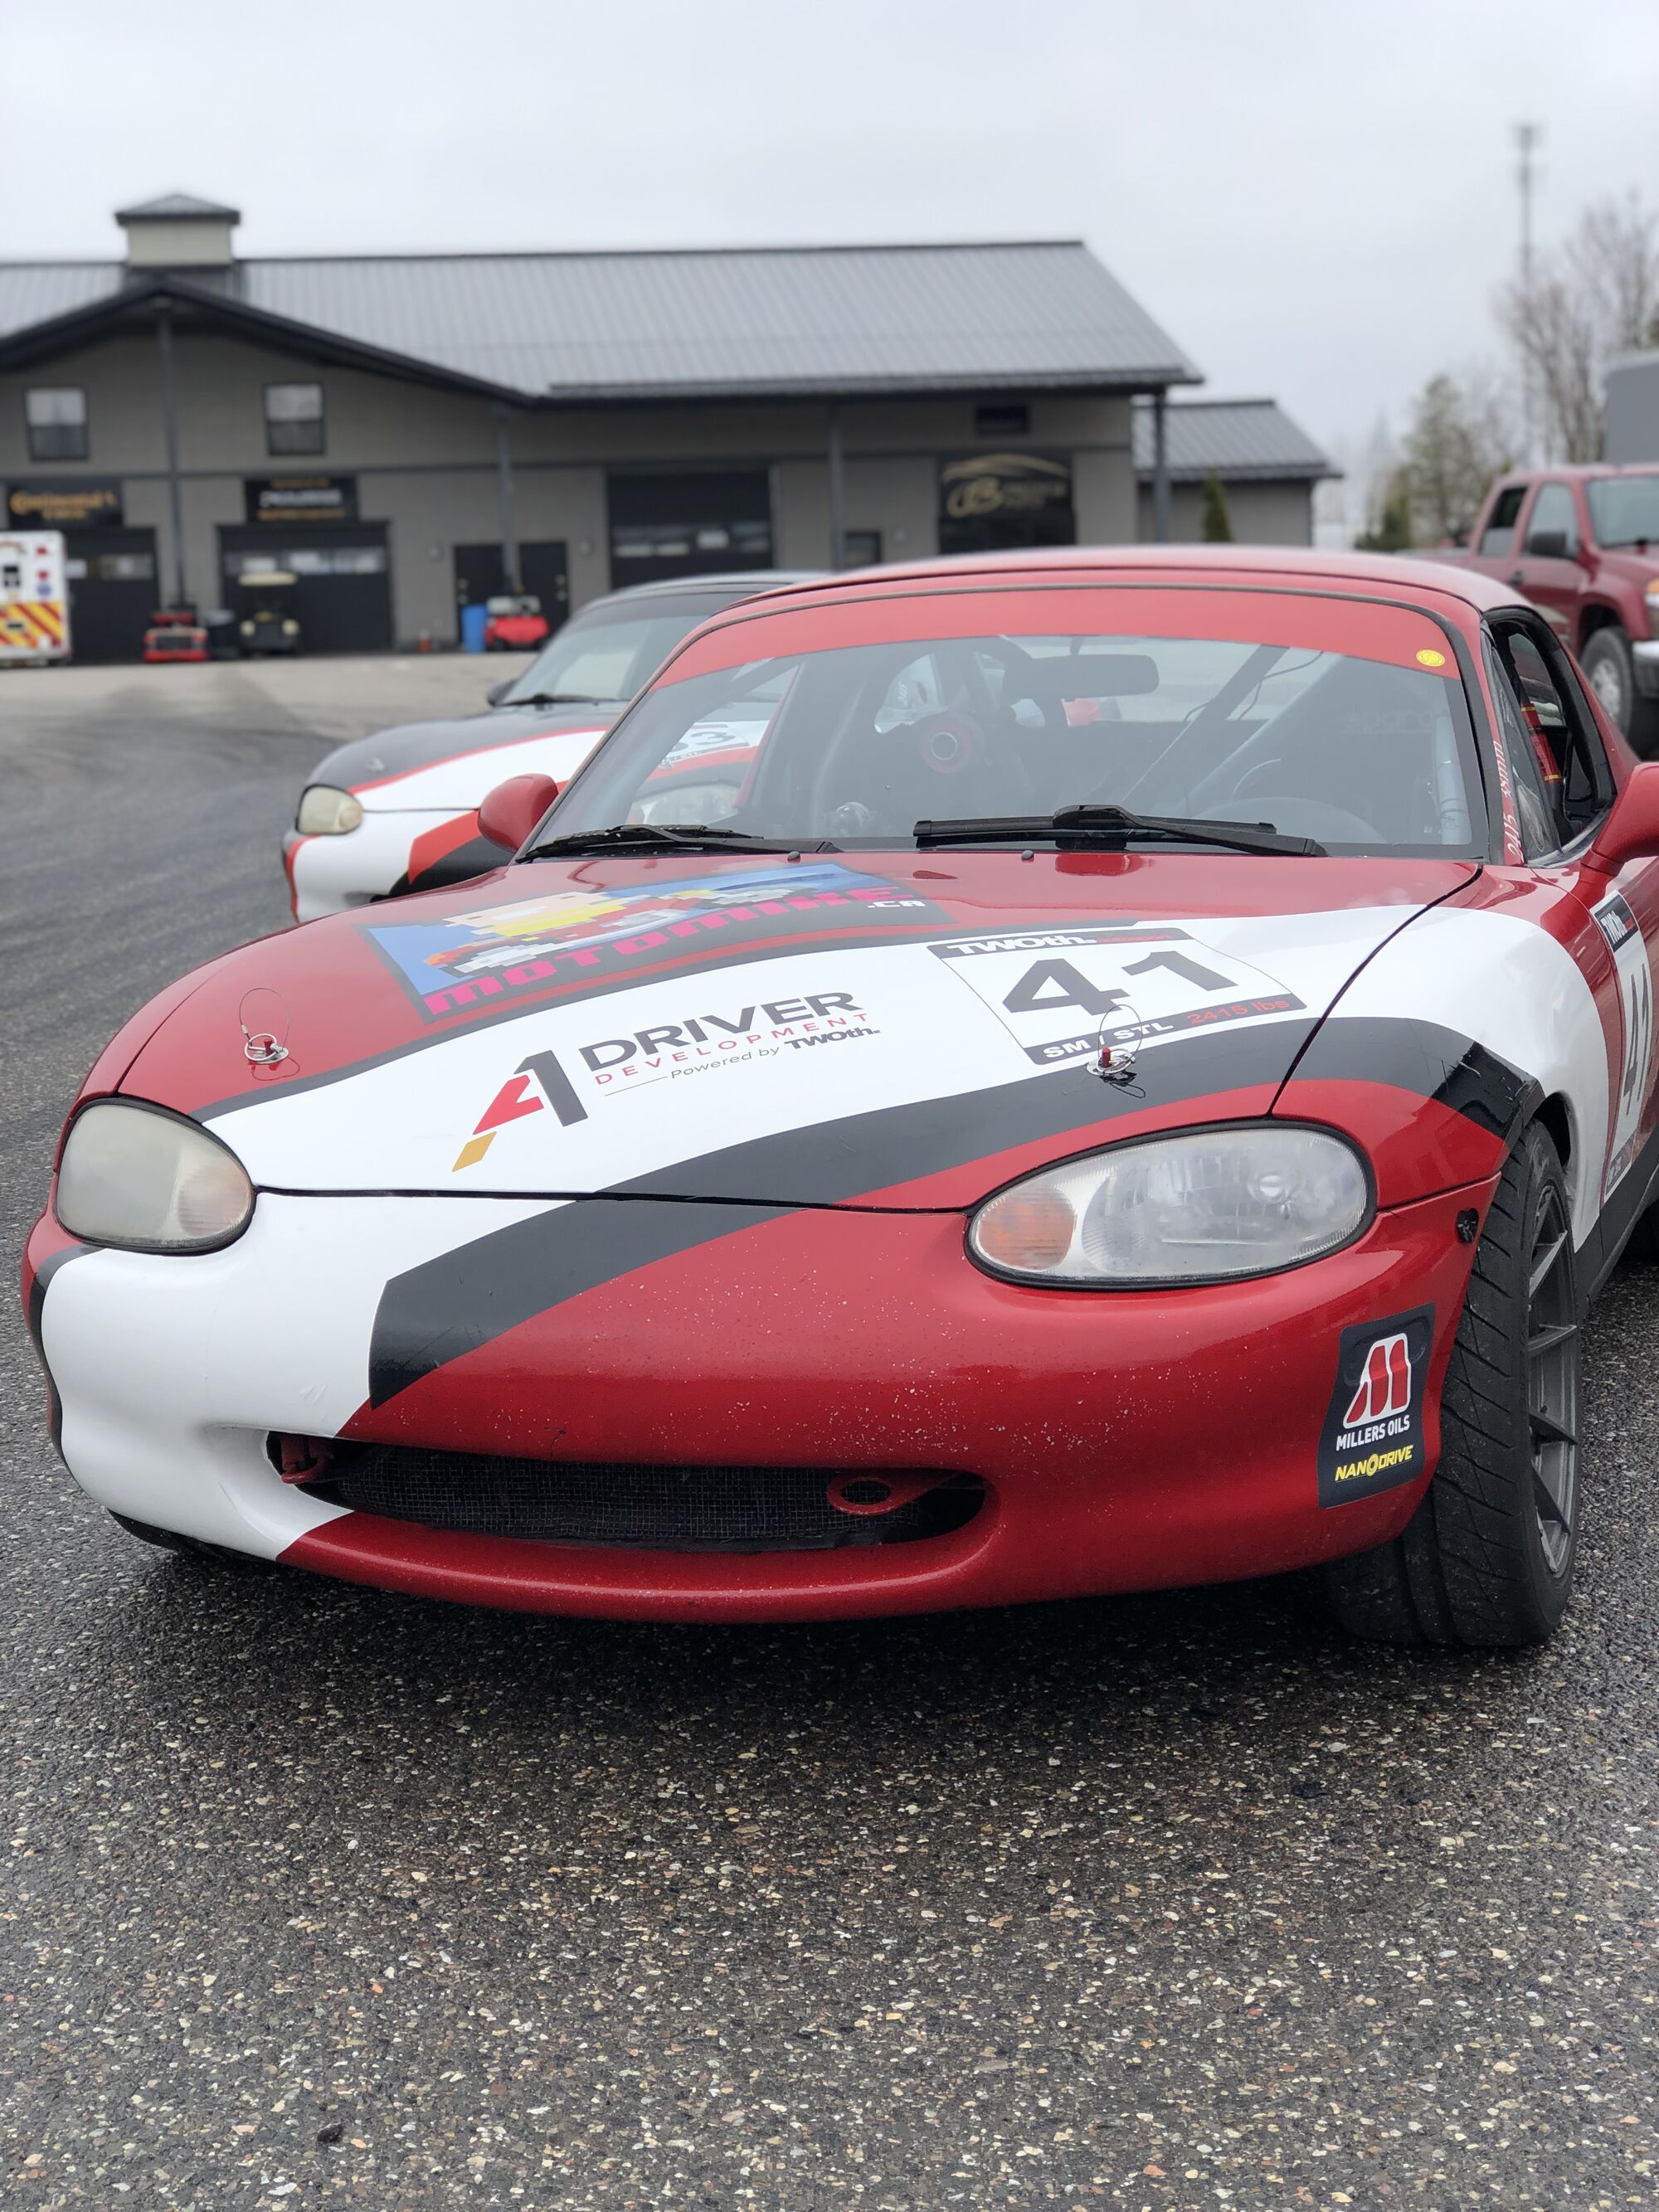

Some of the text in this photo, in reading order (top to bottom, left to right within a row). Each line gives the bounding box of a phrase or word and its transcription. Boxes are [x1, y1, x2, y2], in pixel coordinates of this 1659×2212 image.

[1503, 812, 1525, 864] 2415
[1002, 950, 1239, 1017] 41
[578, 992, 864, 1072] DRIVER
[595, 1013, 868, 1085] DEVELOPMENT
[1042, 1039, 1092, 1058] SM
[1113, 1021, 1175, 1040] STL
[1186, 1004, 1248, 1024] 2415
[1251, 999, 1291, 1013] lbs
[670, 1051, 752, 1079] Powered
[758, 1046, 781, 1057] by
[1335, 1414, 1410, 1451] MILLERS OILS
